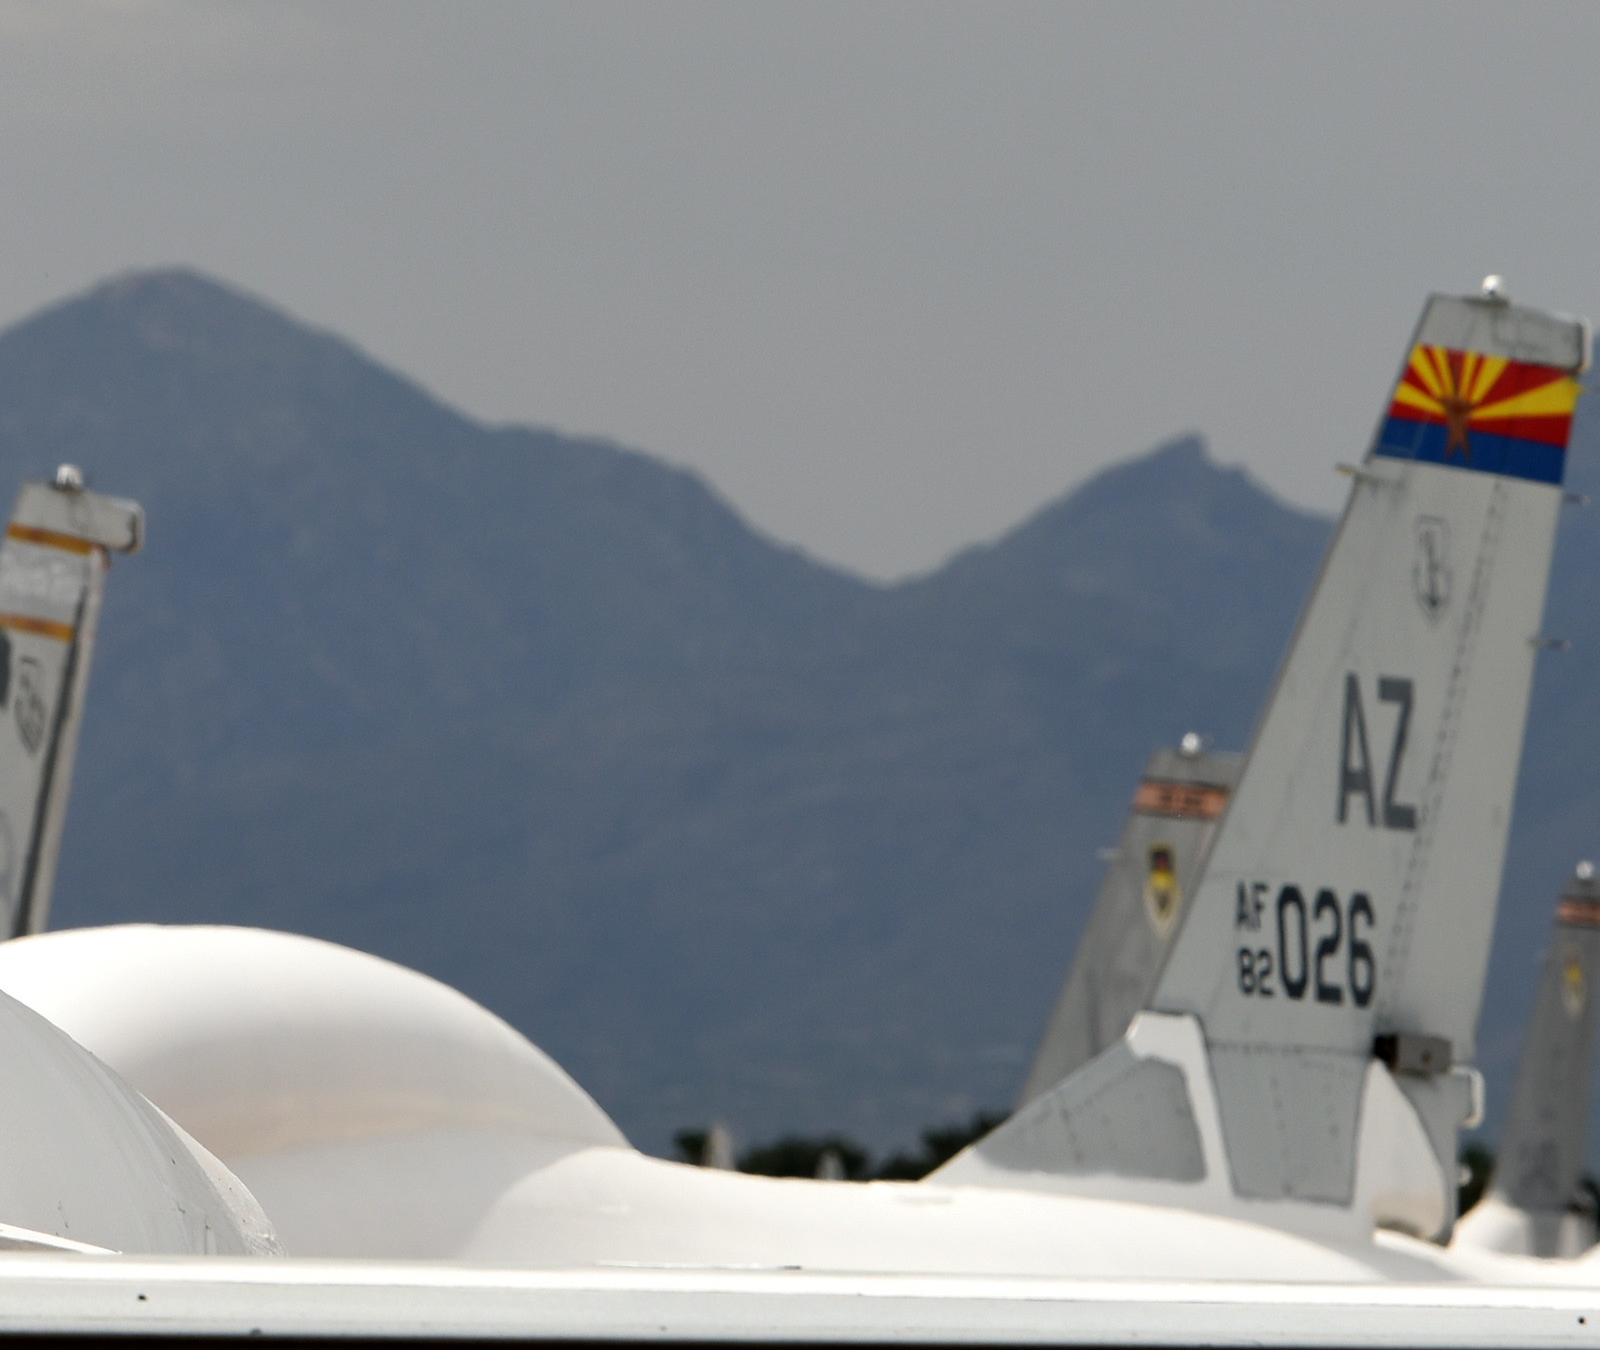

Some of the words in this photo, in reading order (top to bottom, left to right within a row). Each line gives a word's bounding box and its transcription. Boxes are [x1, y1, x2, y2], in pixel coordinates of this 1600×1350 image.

[1337, 672, 1418, 832] AZ
[1236, 882, 1269, 931] AF
[1275, 884, 1376, 1010] 026
[1237, 947, 1275, 998] 82
